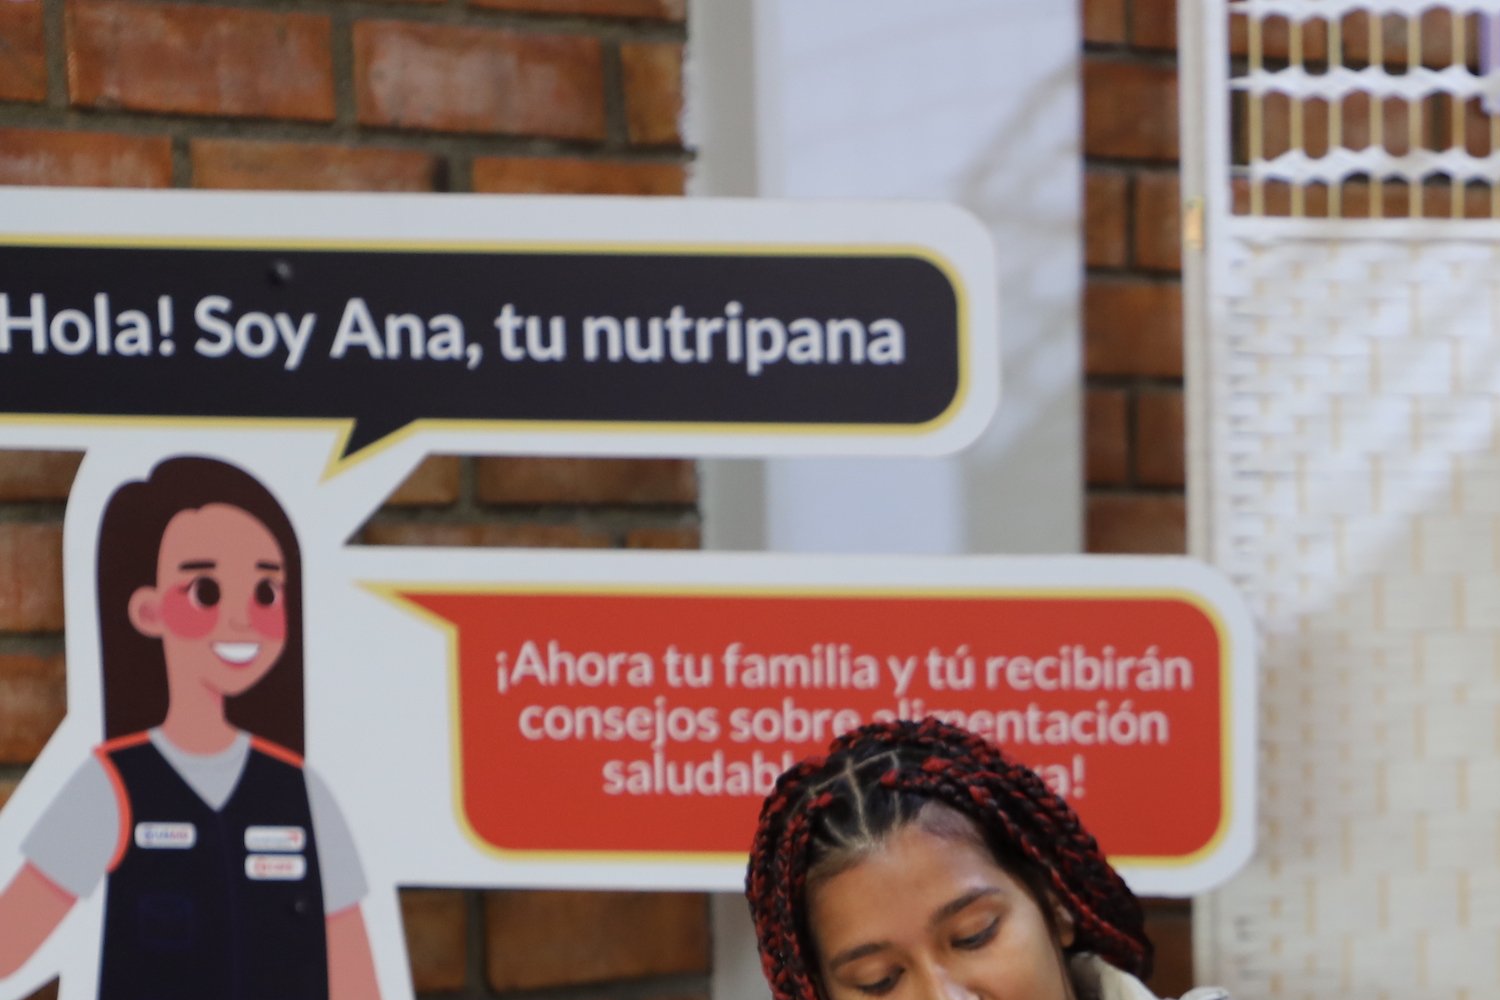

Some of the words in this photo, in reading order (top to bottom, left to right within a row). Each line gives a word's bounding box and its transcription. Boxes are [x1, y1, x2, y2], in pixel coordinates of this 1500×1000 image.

[0, 292, 175, 357] Hola!
[194, 294, 316, 371] Soy
[329, 297, 484, 371] Ana,
[494, 303, 567, 363] tu
[582, 300, 906, 376] nutripana
[495, 640, 652, 694] ¡Ahora
[663, 644, 713, 688] tu
[722, 642, 880, 690] familia
[887, 654, 918, 697] y
[926, 645, 976, 690] tú
[986, 645, 1194, 691] recibirán
[518, 694, 721, 750] consejos
[729, 696, 862, 743] sobre
